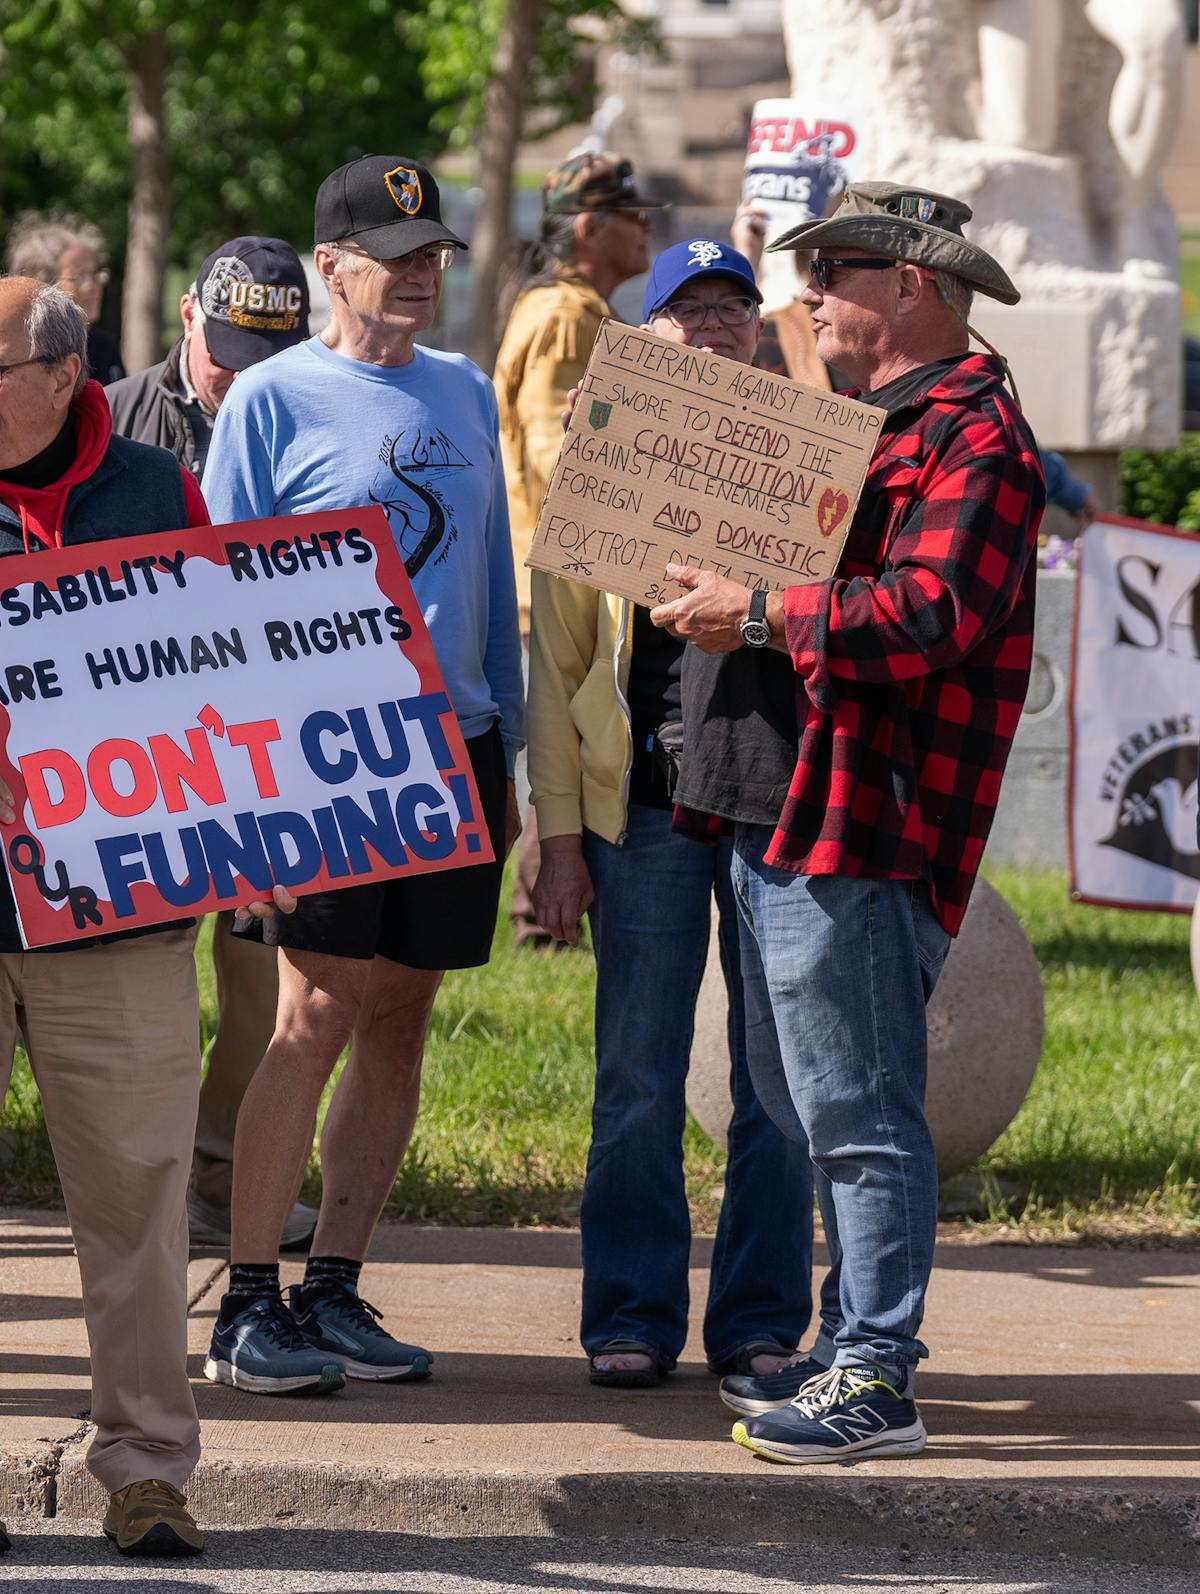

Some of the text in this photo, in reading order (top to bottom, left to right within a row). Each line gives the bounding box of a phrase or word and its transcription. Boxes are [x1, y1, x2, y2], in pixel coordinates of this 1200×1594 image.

[231, 283, 301, 312] USMC
[604, 329, 880, 433] VETERANS AGAINST TRUMP
[378, 434, 392, 466] 2013
[565, 433, 661, 480] AGAINST
[664, 466, 699, 491] ALL
[584, 373, 603, 396] I
[605, 383, 672, 422] SWORE
[682, 404, 711, 431] TO
[800, 441, 842, 475] THE
[634, 429, 815, 504] CONSTITUTION
[225, 528, 373, 582] RIGHTS
[544, 515, 658, 572] FOXTROT
[557, 466, 825, 576] FOREIGN AND DOMESTIC
[645, 584, 666, 604] 86
[85, 627, 247, 690] HUMAN
[264, 605, 412, 662] RIGHTS
[17, 691, 456, 830] DON'T CUT
[1101, 713, 1193, 802] VETERANS
[9, 774, 481, 929] OUR FUNDING!
